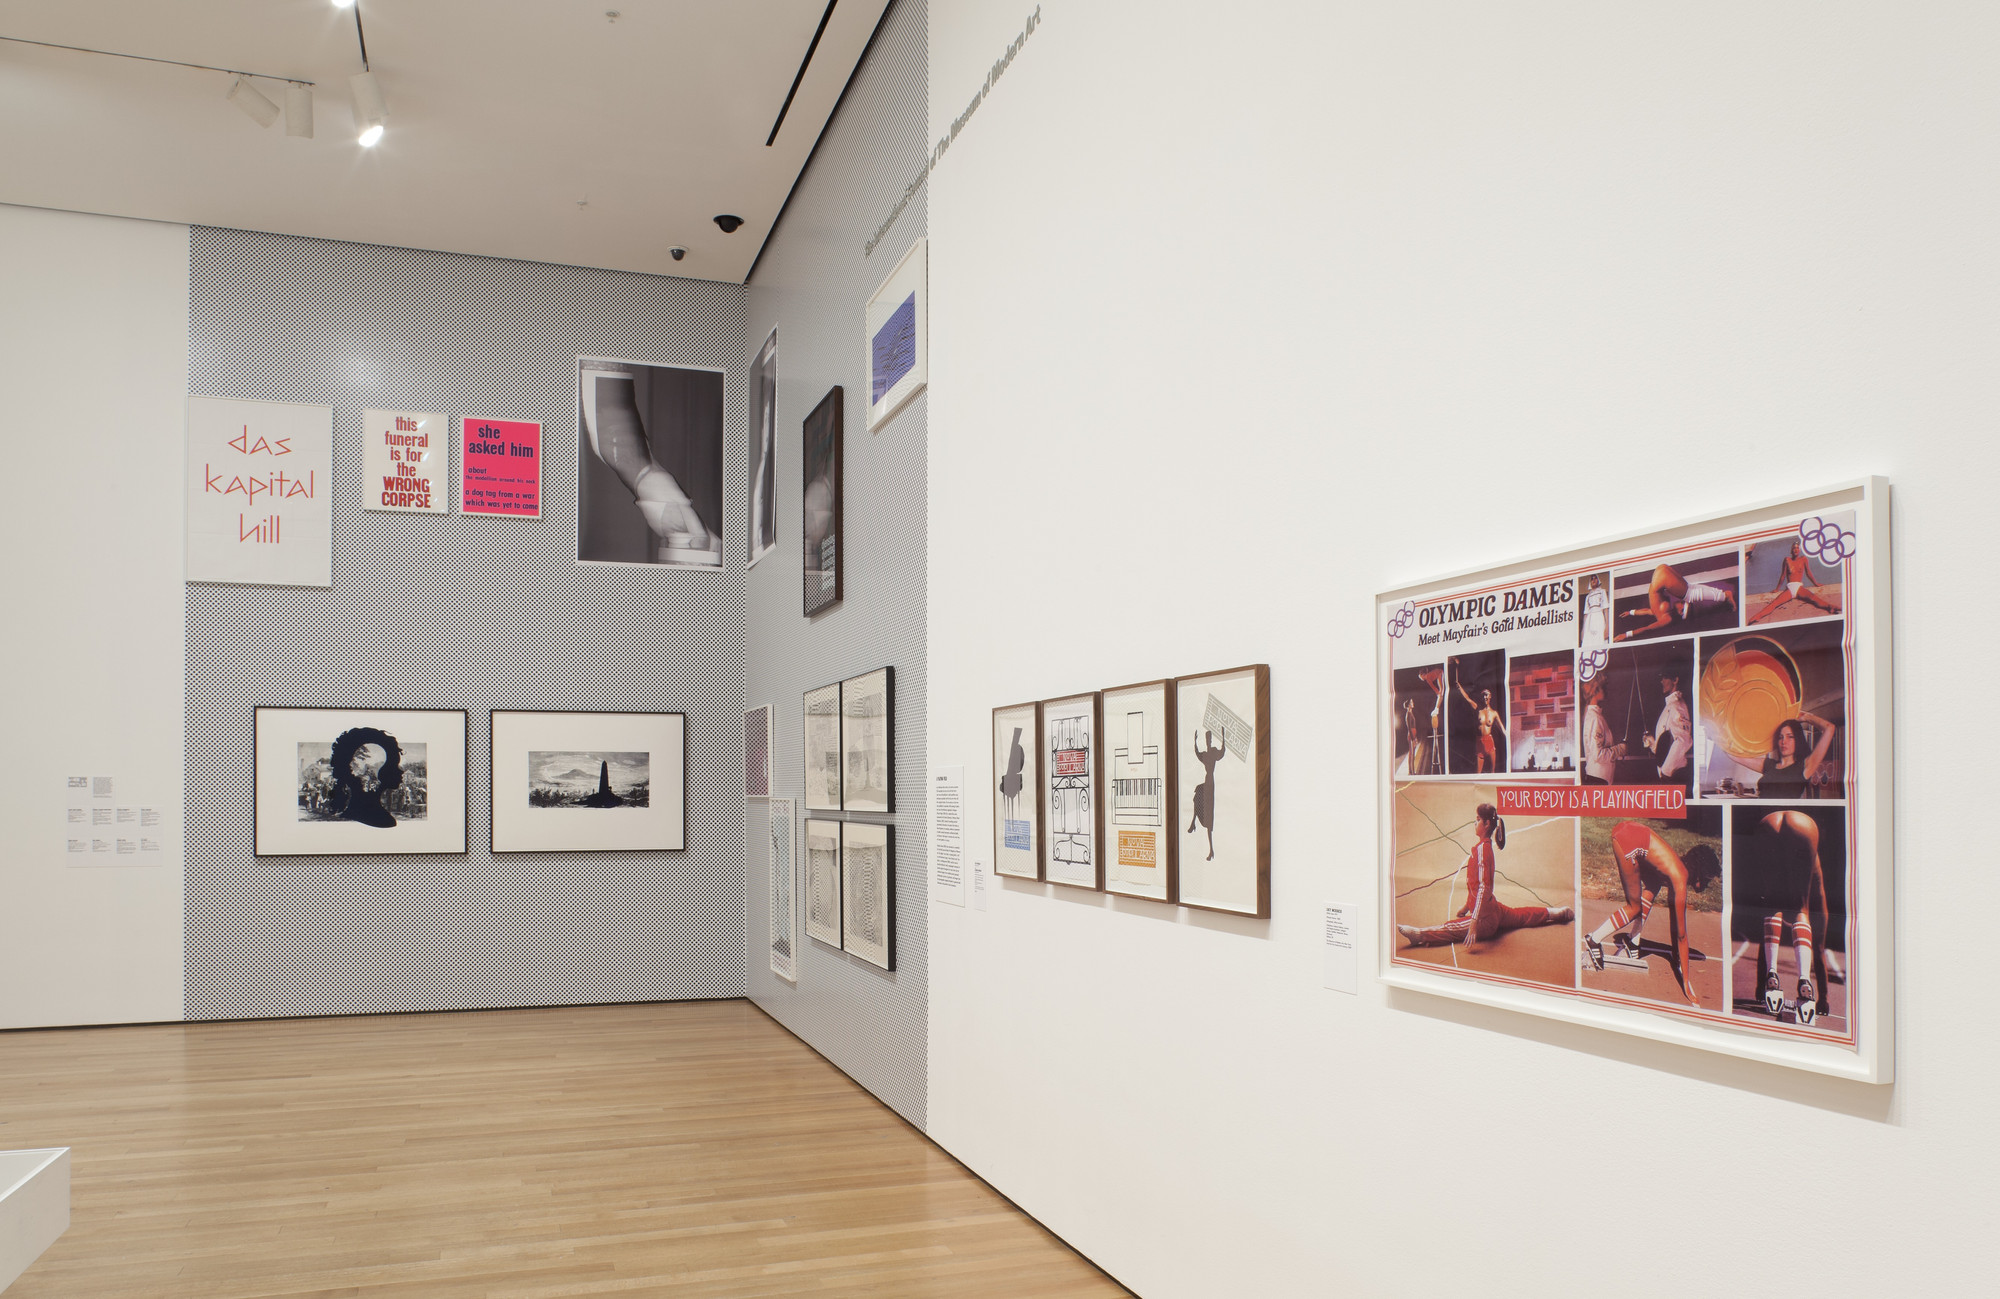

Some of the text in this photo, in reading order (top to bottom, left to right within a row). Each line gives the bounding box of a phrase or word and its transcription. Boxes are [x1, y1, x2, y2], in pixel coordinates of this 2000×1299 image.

[930, 4, 1041, 170] of The Museum of Modern Art
[396, 417, 418, 431] this
[478, 425, 501, 439] she
[228, 424, 292, 456] das
[385, 431, 428, 447] funeral
[390, 448, 422, 462] is for
[468, 440, 534, 458] asked him
[396, 462, 417, 476] the
[468, 466, 487, 474] about
[205, 463, 314, 506] kapital
[383, 477, 429, 492] WRONG
[382, 492, 431, 508] CORPSE
[472, 489, 483, 497] dog
[486, 490, 496, 498] tag
[499, 490, 513, 498] from
[239, 513, 280, 544] hill
[1420, 580, 1574, 627] OLYMPIC DAMES
[1418, 631, 1440, 647] Meet
[1491, 616, 1515, 635] Gold
[1518, 610, 1574, 629] Modellists
[1500, 790, 1683, 809] YOUR BODY IS A PLAYINGFIELD
